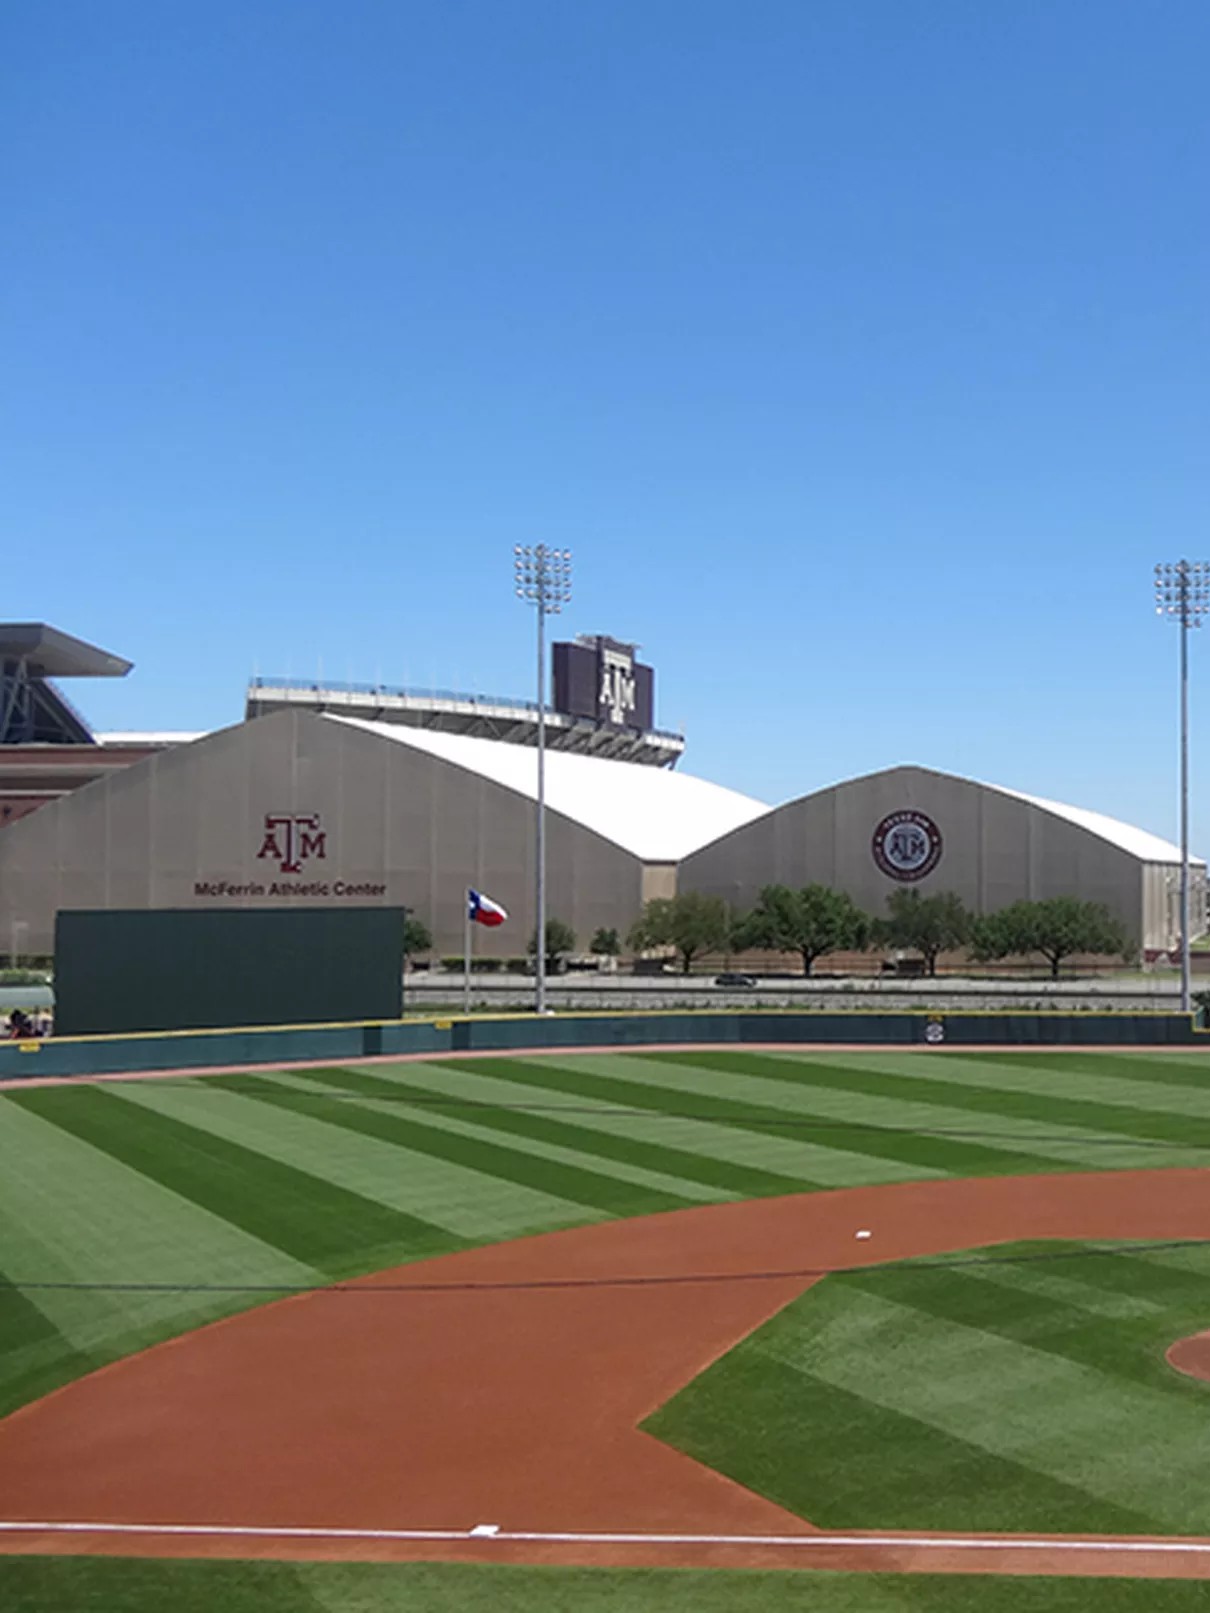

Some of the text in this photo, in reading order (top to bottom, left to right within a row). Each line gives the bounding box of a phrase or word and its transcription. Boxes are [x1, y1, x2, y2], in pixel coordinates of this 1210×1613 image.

[194, 882, 386, 895] McFerrin Athletic Center
